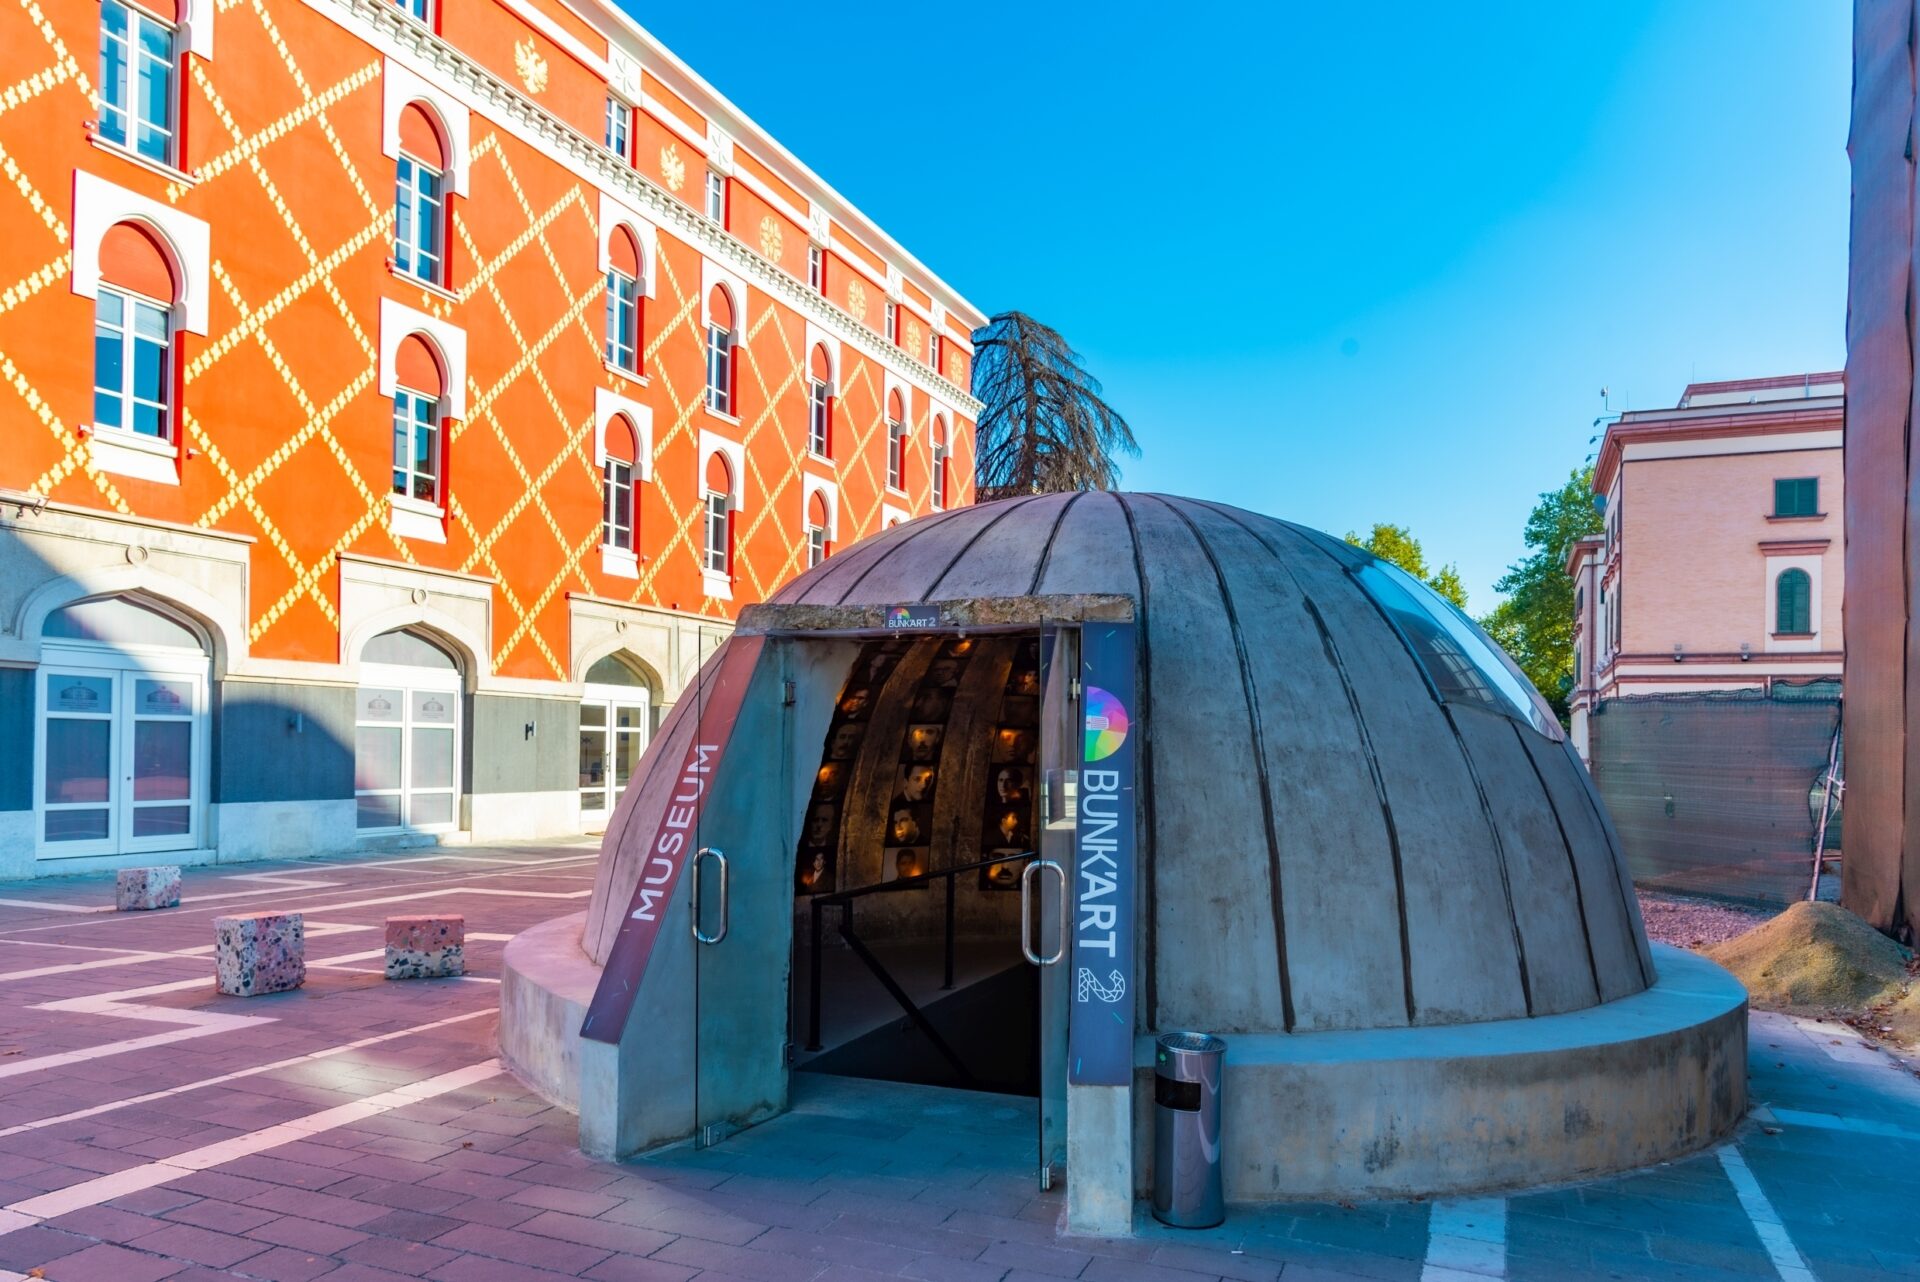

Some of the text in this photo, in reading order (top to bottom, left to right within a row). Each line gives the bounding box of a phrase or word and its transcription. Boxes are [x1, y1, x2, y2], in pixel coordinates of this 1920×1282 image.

[888, 617, 936, 628] BUNK'ART 2
[632, 744, 719, 921] MUSEUM
[1078, 769, 1126, 1003] BUNK'ART 2
